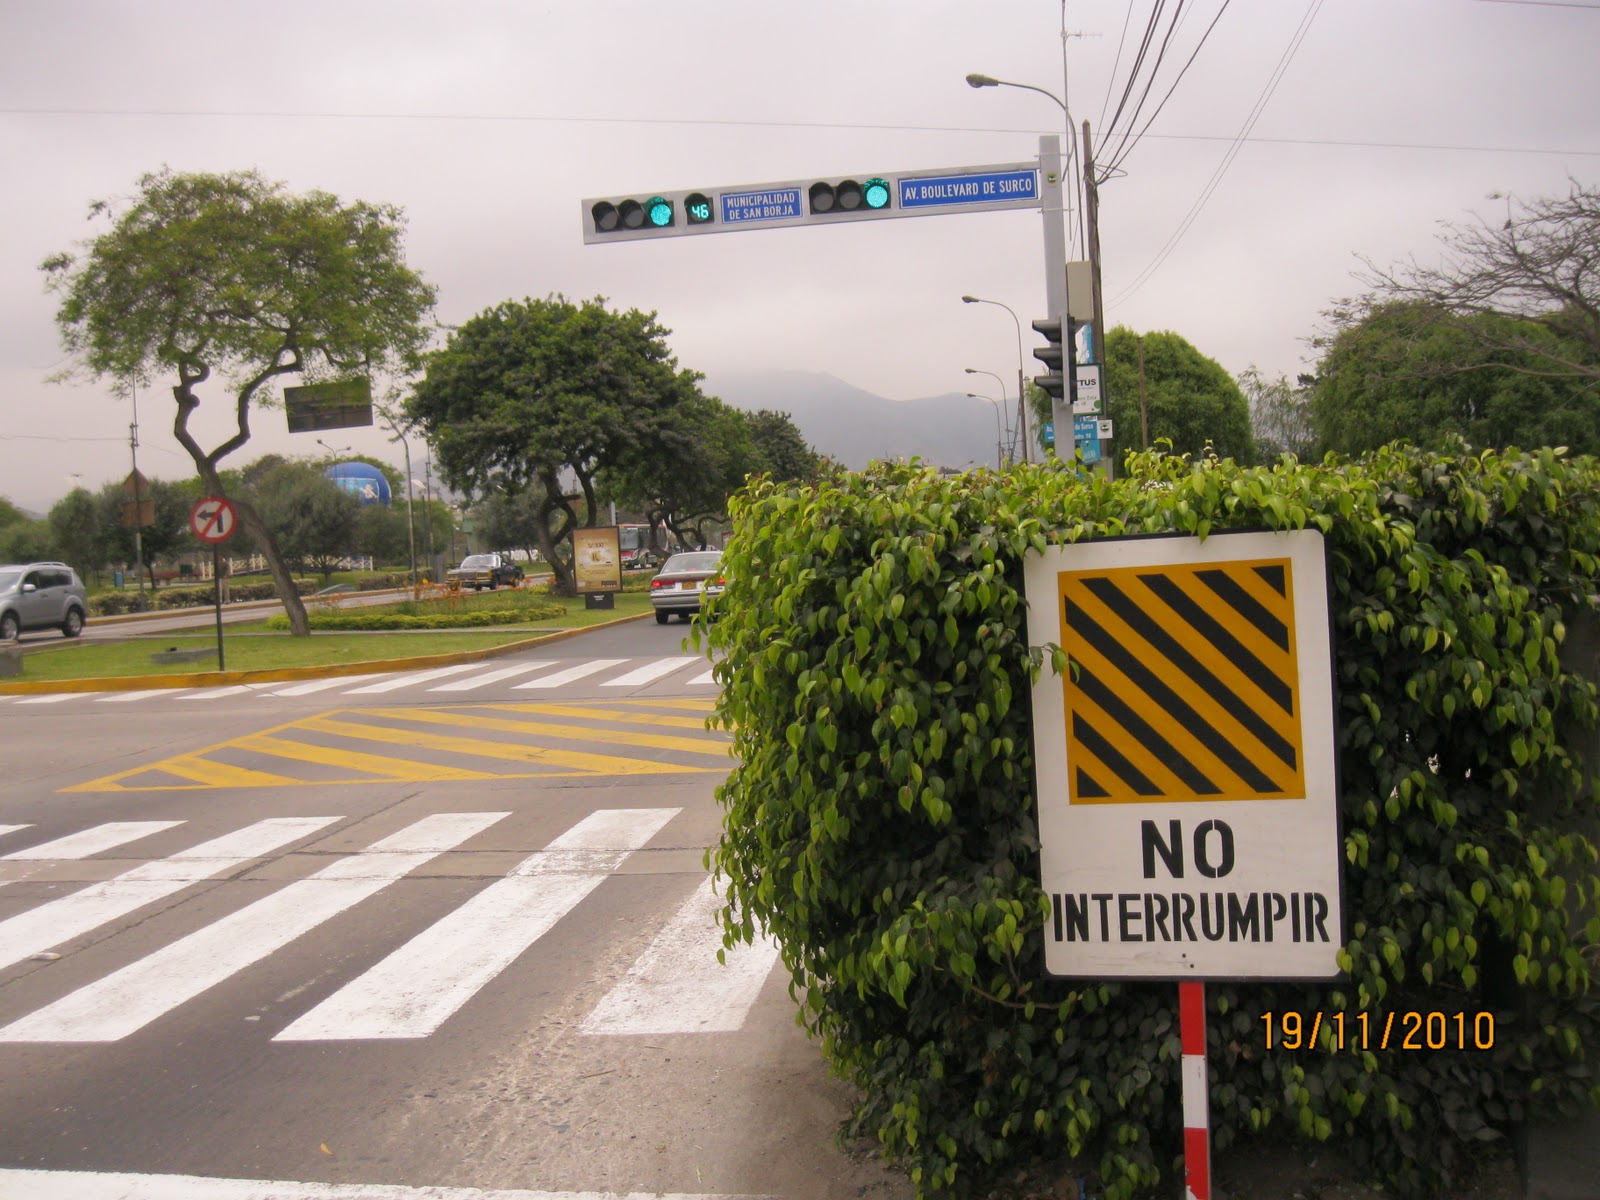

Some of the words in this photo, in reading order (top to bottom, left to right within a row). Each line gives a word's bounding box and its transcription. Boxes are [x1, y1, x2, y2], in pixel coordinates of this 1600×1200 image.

[904, 187, 919, 200] AV.
[921, 182, 979, 199] BOULEVARD
[983, 181, 996, 194] DE
[1000, 178, 1032, 193] SURCO
[727, 192, 795, 208] MUNICIPALIDAD
[691, 204, 709, 219] 46
[729, 210, 740, 220] DE
[743, 207, 762, 219] SAN
[764, 205, 794, 218] BORJA
[1076, 378, 1097, 387] TUS
[1141, 819, 1235, 879] NO
[1053, 892, 1330, 942] INTERRUMPIR
